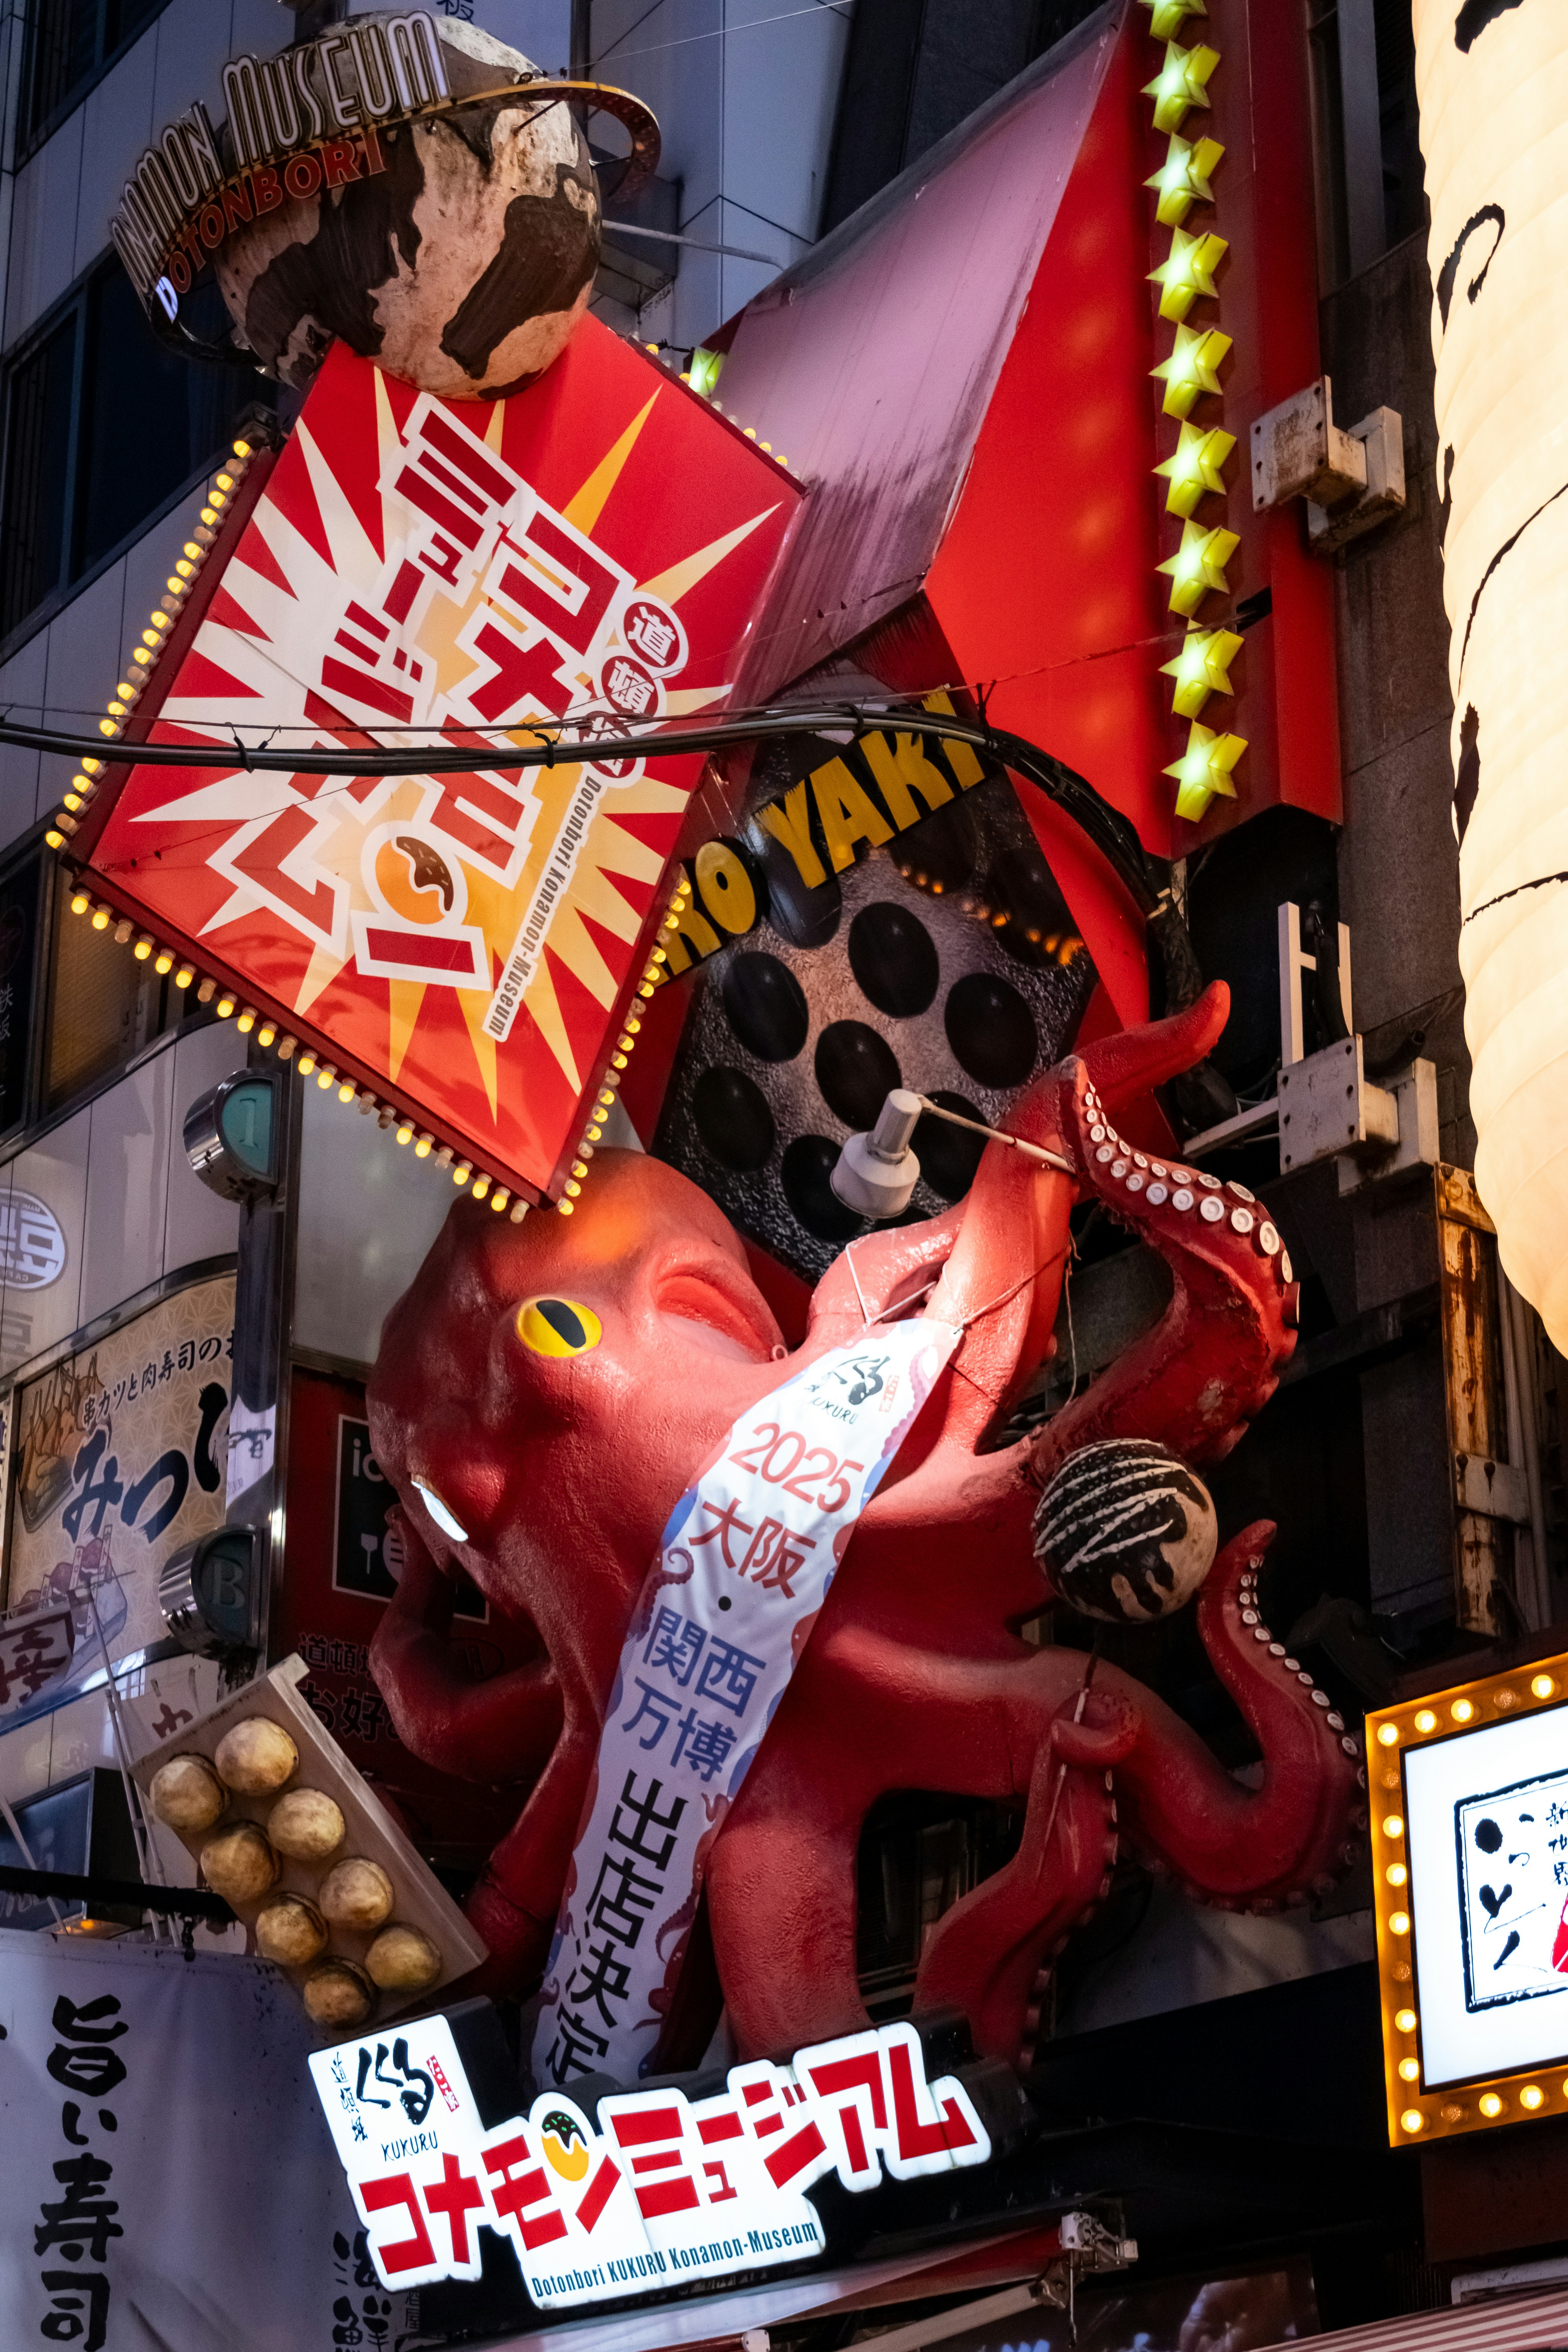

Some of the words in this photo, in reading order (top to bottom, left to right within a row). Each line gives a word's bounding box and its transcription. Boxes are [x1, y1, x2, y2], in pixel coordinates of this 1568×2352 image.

[111, 100, 225, 314] ONAMON
[221, 10, 452, 166] MUSEUM
[156, 130, 387, 323] DOTONBORI
[557, 775, 602, 870] Dotonbori
[753, 684, 985, 889] YAKI
[488, 866, 566, 1036] Konamon-Museum
[808, 1396, 858, 1424] UKURU
[728, 1421, 864, 1514] 2025
[688, 1498, 815, 1599] 大阪
[643, 1607, 766, 1717] 関西
[622, 1677, 738, 1784] 万博
[545, 1768, 689, 2084] 出店決定
[356, 2037, 434, 2125] くくる
[34, 1994, 129, 2352] 旨い寿司
[381, 2131, 438, 2161] KUKURU
[531, 2264, 607, 2298] Dotonbori
[607, 2251, 667, 2283] KUKURU
[669, 2221, 818, 2270] Konamon-Museum
